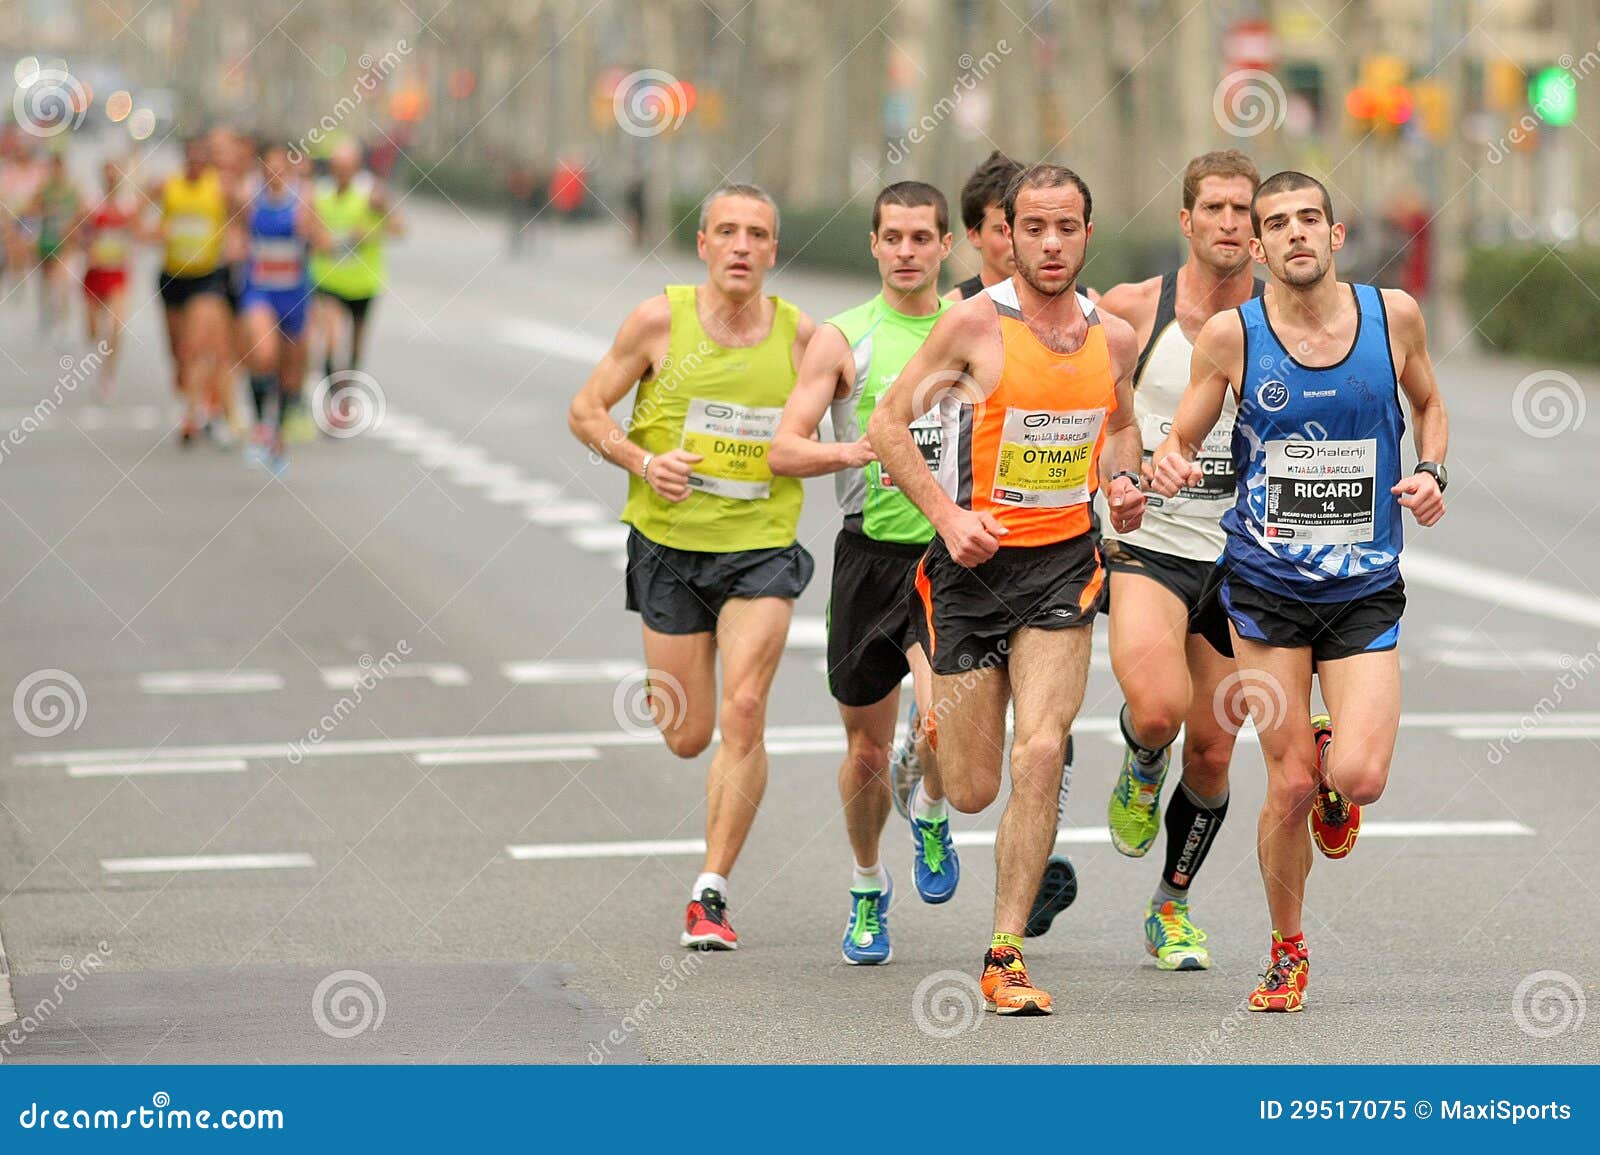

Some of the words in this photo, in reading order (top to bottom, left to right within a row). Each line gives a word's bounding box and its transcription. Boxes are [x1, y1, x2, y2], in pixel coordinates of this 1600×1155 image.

[1267, 387, 1285, 402] 25
[913, 430, 943, 446] MA
[713, 440, 764, 458] DARIO
[1023, 446, 1089, 464] OTMANE
[1317, 447, 1366, 458] Kalenji
[1048, 467, 1067, 478] 351
[1201, 459, 1235, 475] CEL
[1294, 482, 1363, 498] RICARD
[1321, 501, 1335, 512] 14
